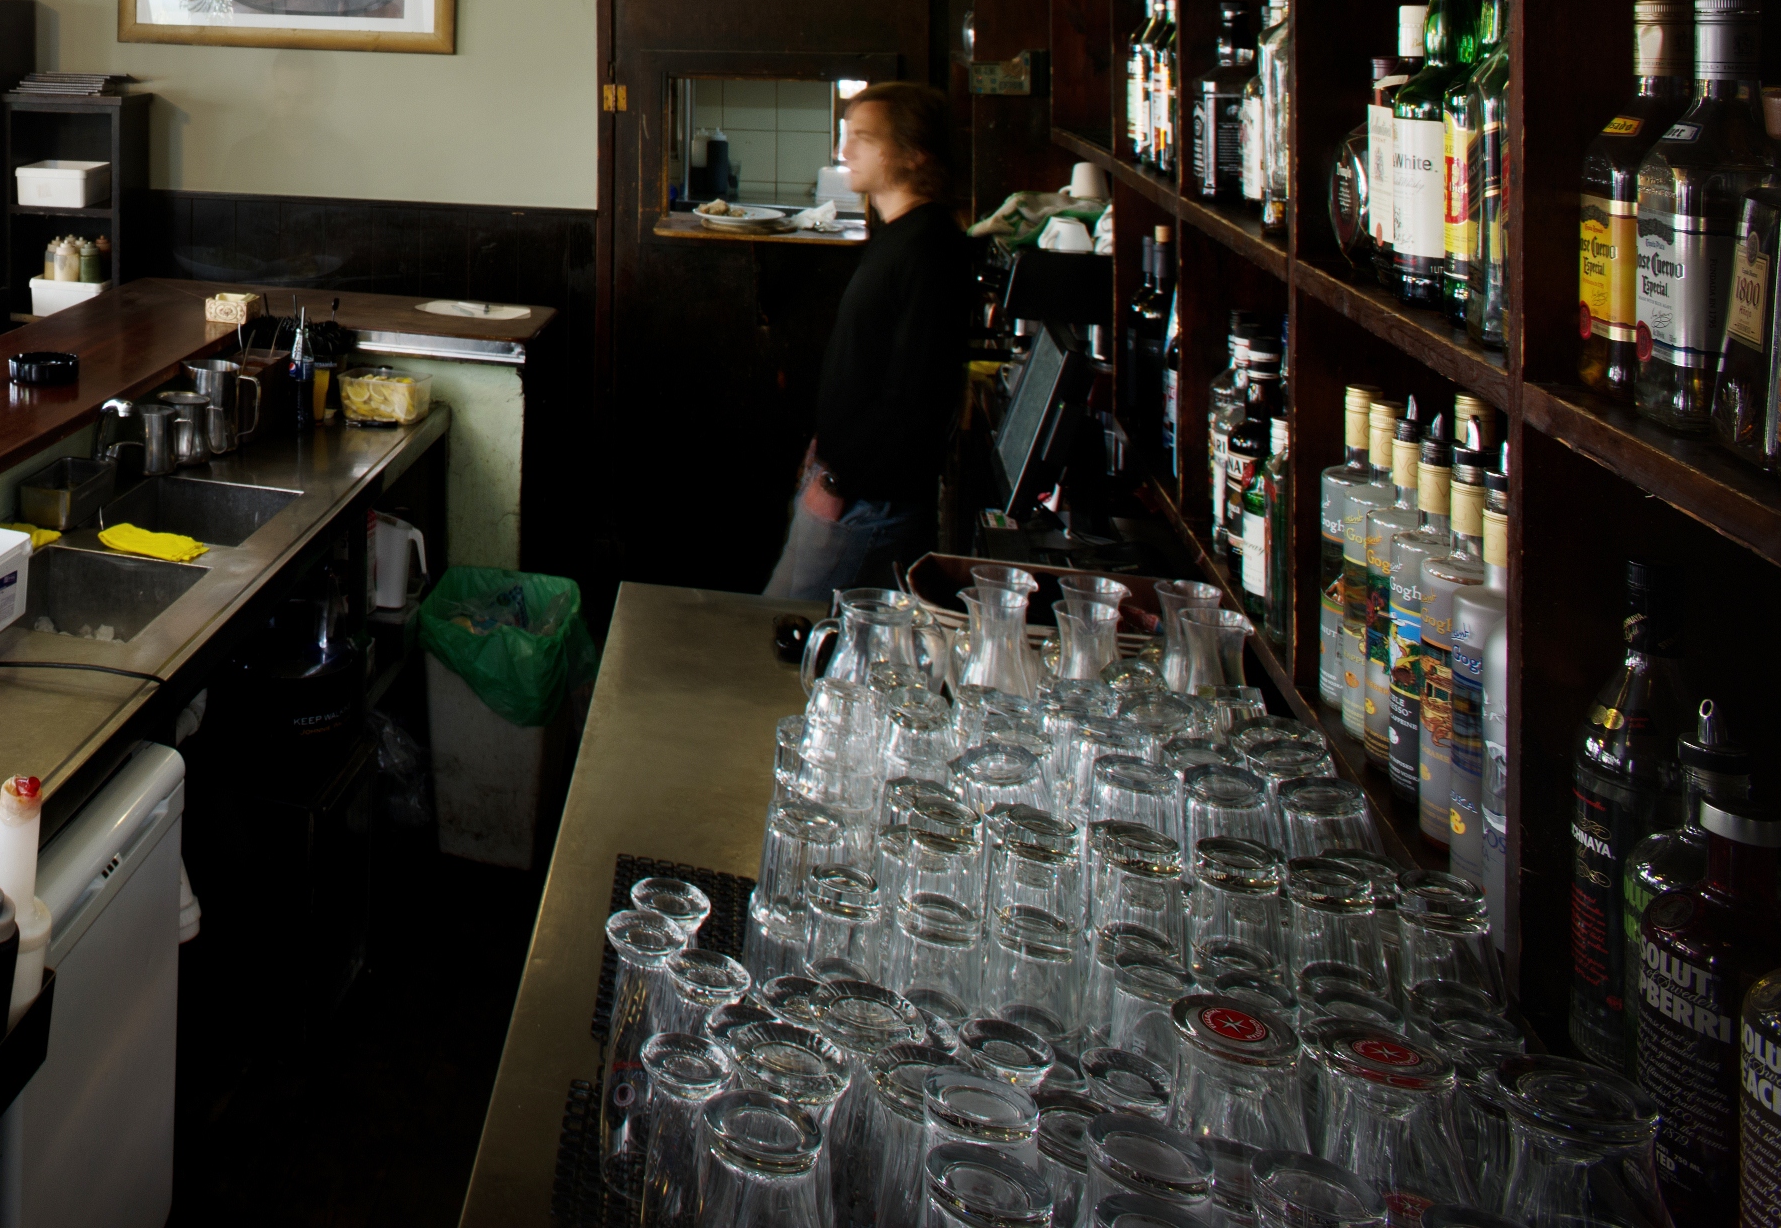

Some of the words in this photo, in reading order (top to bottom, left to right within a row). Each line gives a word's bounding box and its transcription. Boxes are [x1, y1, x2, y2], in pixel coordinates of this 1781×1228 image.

[1591, 236, 1617, 261] Cuervo
[1651, 252, 1685, 280] Cuervo
[1708, 296, 1717, 308] EN
[1735, 275, 1761, 307] 1800
[1708, 309, 1717, 329] 1795
[1389, 576, 1422, 601] Gogh
[1659, 975, 1718, 1012] Sweden
[1660, 1037, 1696, 1064] blended
[1696, 1095, 1732, 1114] vodka
[1668, 1105, 1693, 1124] 400
[1692, 1116, 1725, 1139] years
[1679, 1124, 1697, 1138] the
[1696, 1134, 1731, 1152] name
